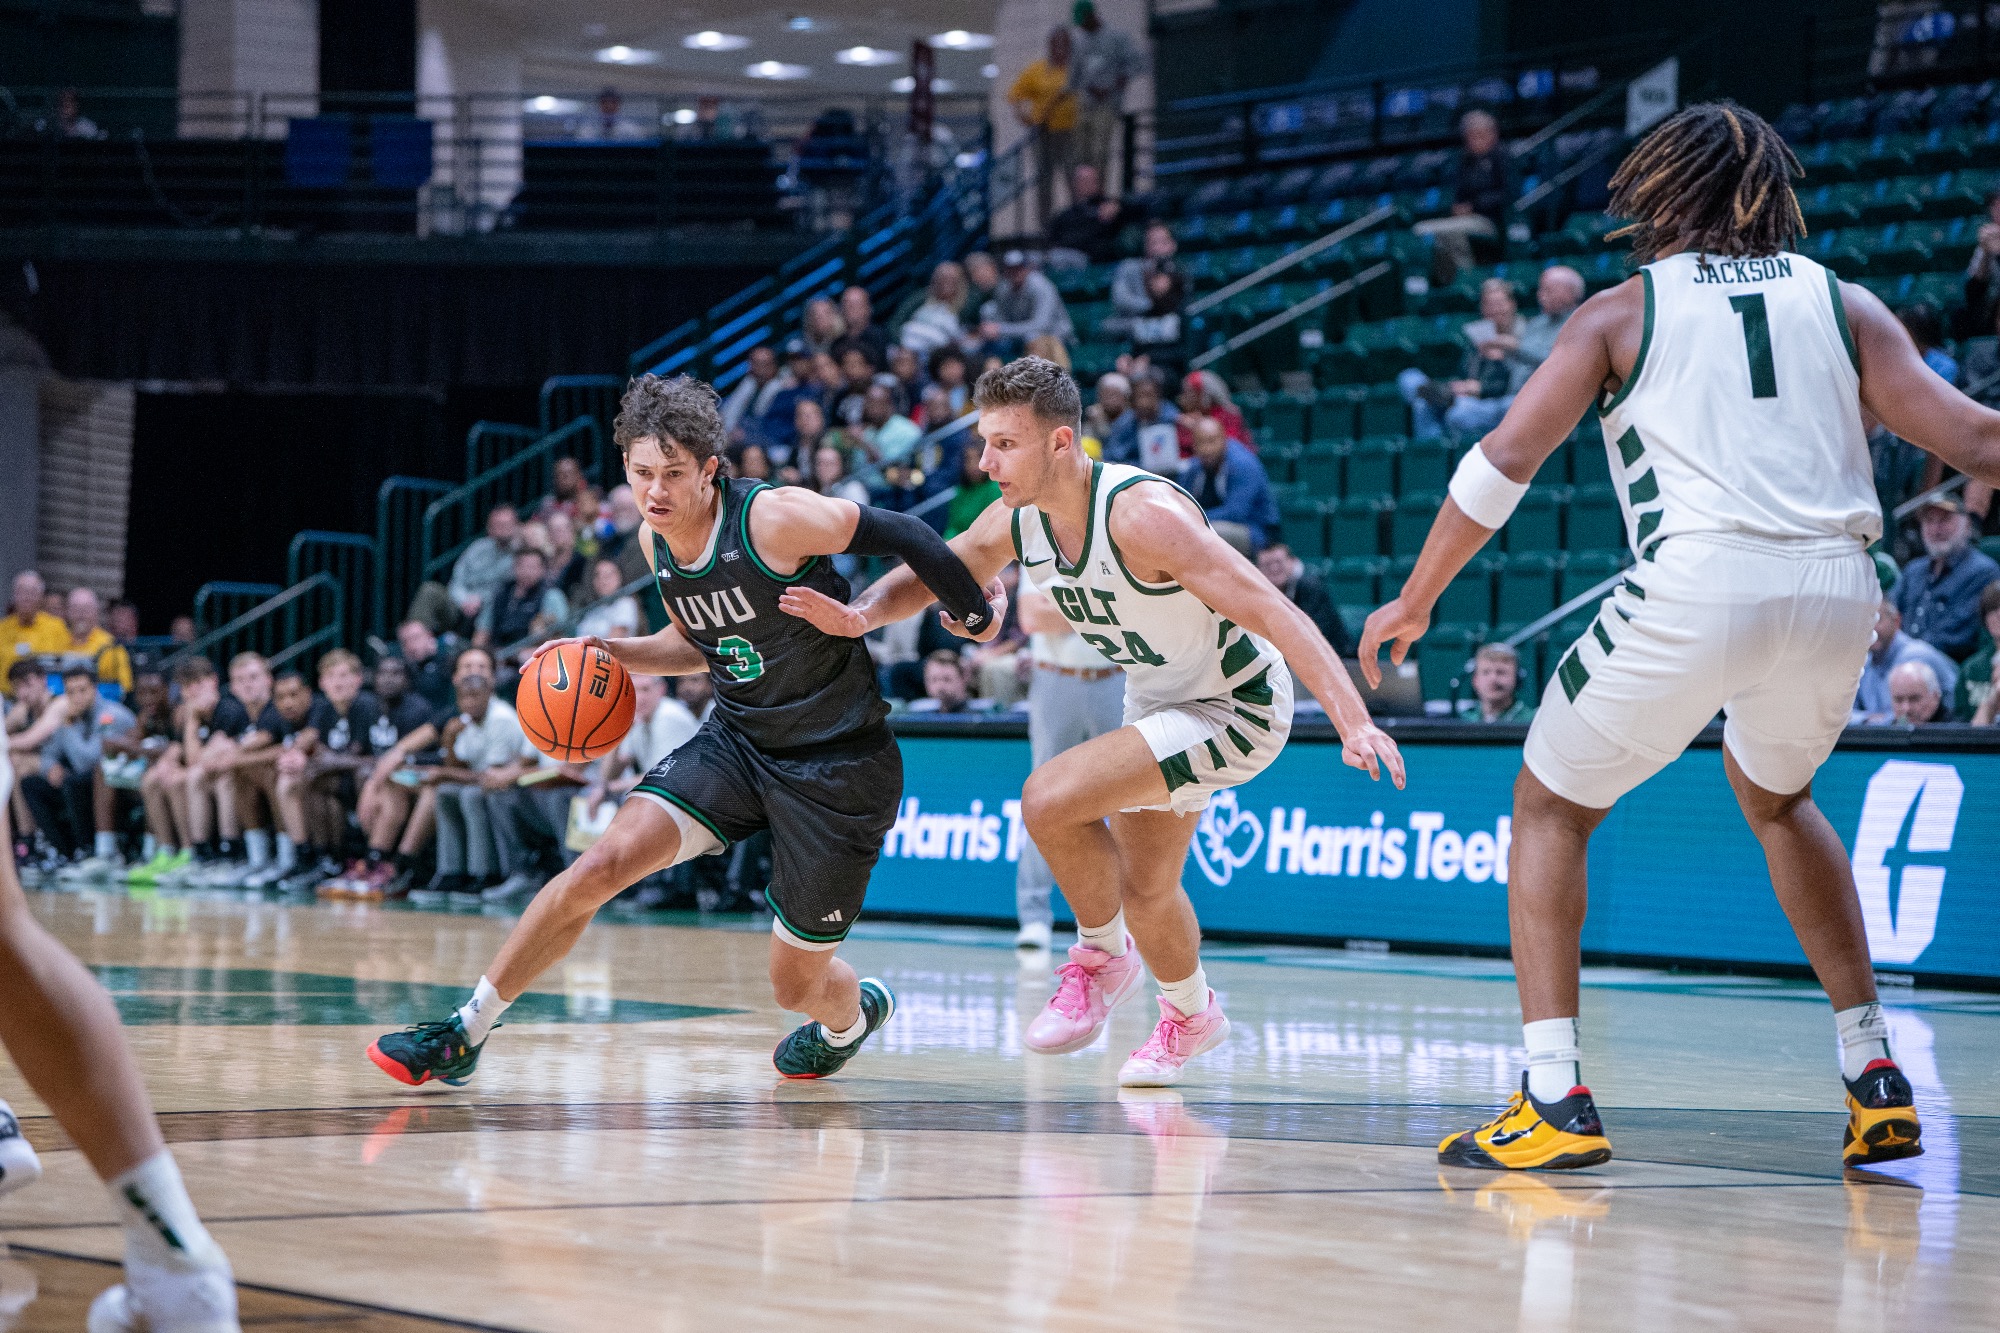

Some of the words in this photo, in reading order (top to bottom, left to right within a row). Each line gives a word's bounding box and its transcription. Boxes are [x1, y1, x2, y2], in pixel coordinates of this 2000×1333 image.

[1693, 257, 1793, 284] JACKSON
[1727, 292, 1779, 399] 1
[675, 585, 757, 631] UVU
[716, 634, 766, 683] 3
[1080, 630, 1169, 667] 24
[588, 649, 612, 699] ELITE
[883, 796, 1002, 863] Harris
[1264, 806, 1408, 880] Harris
